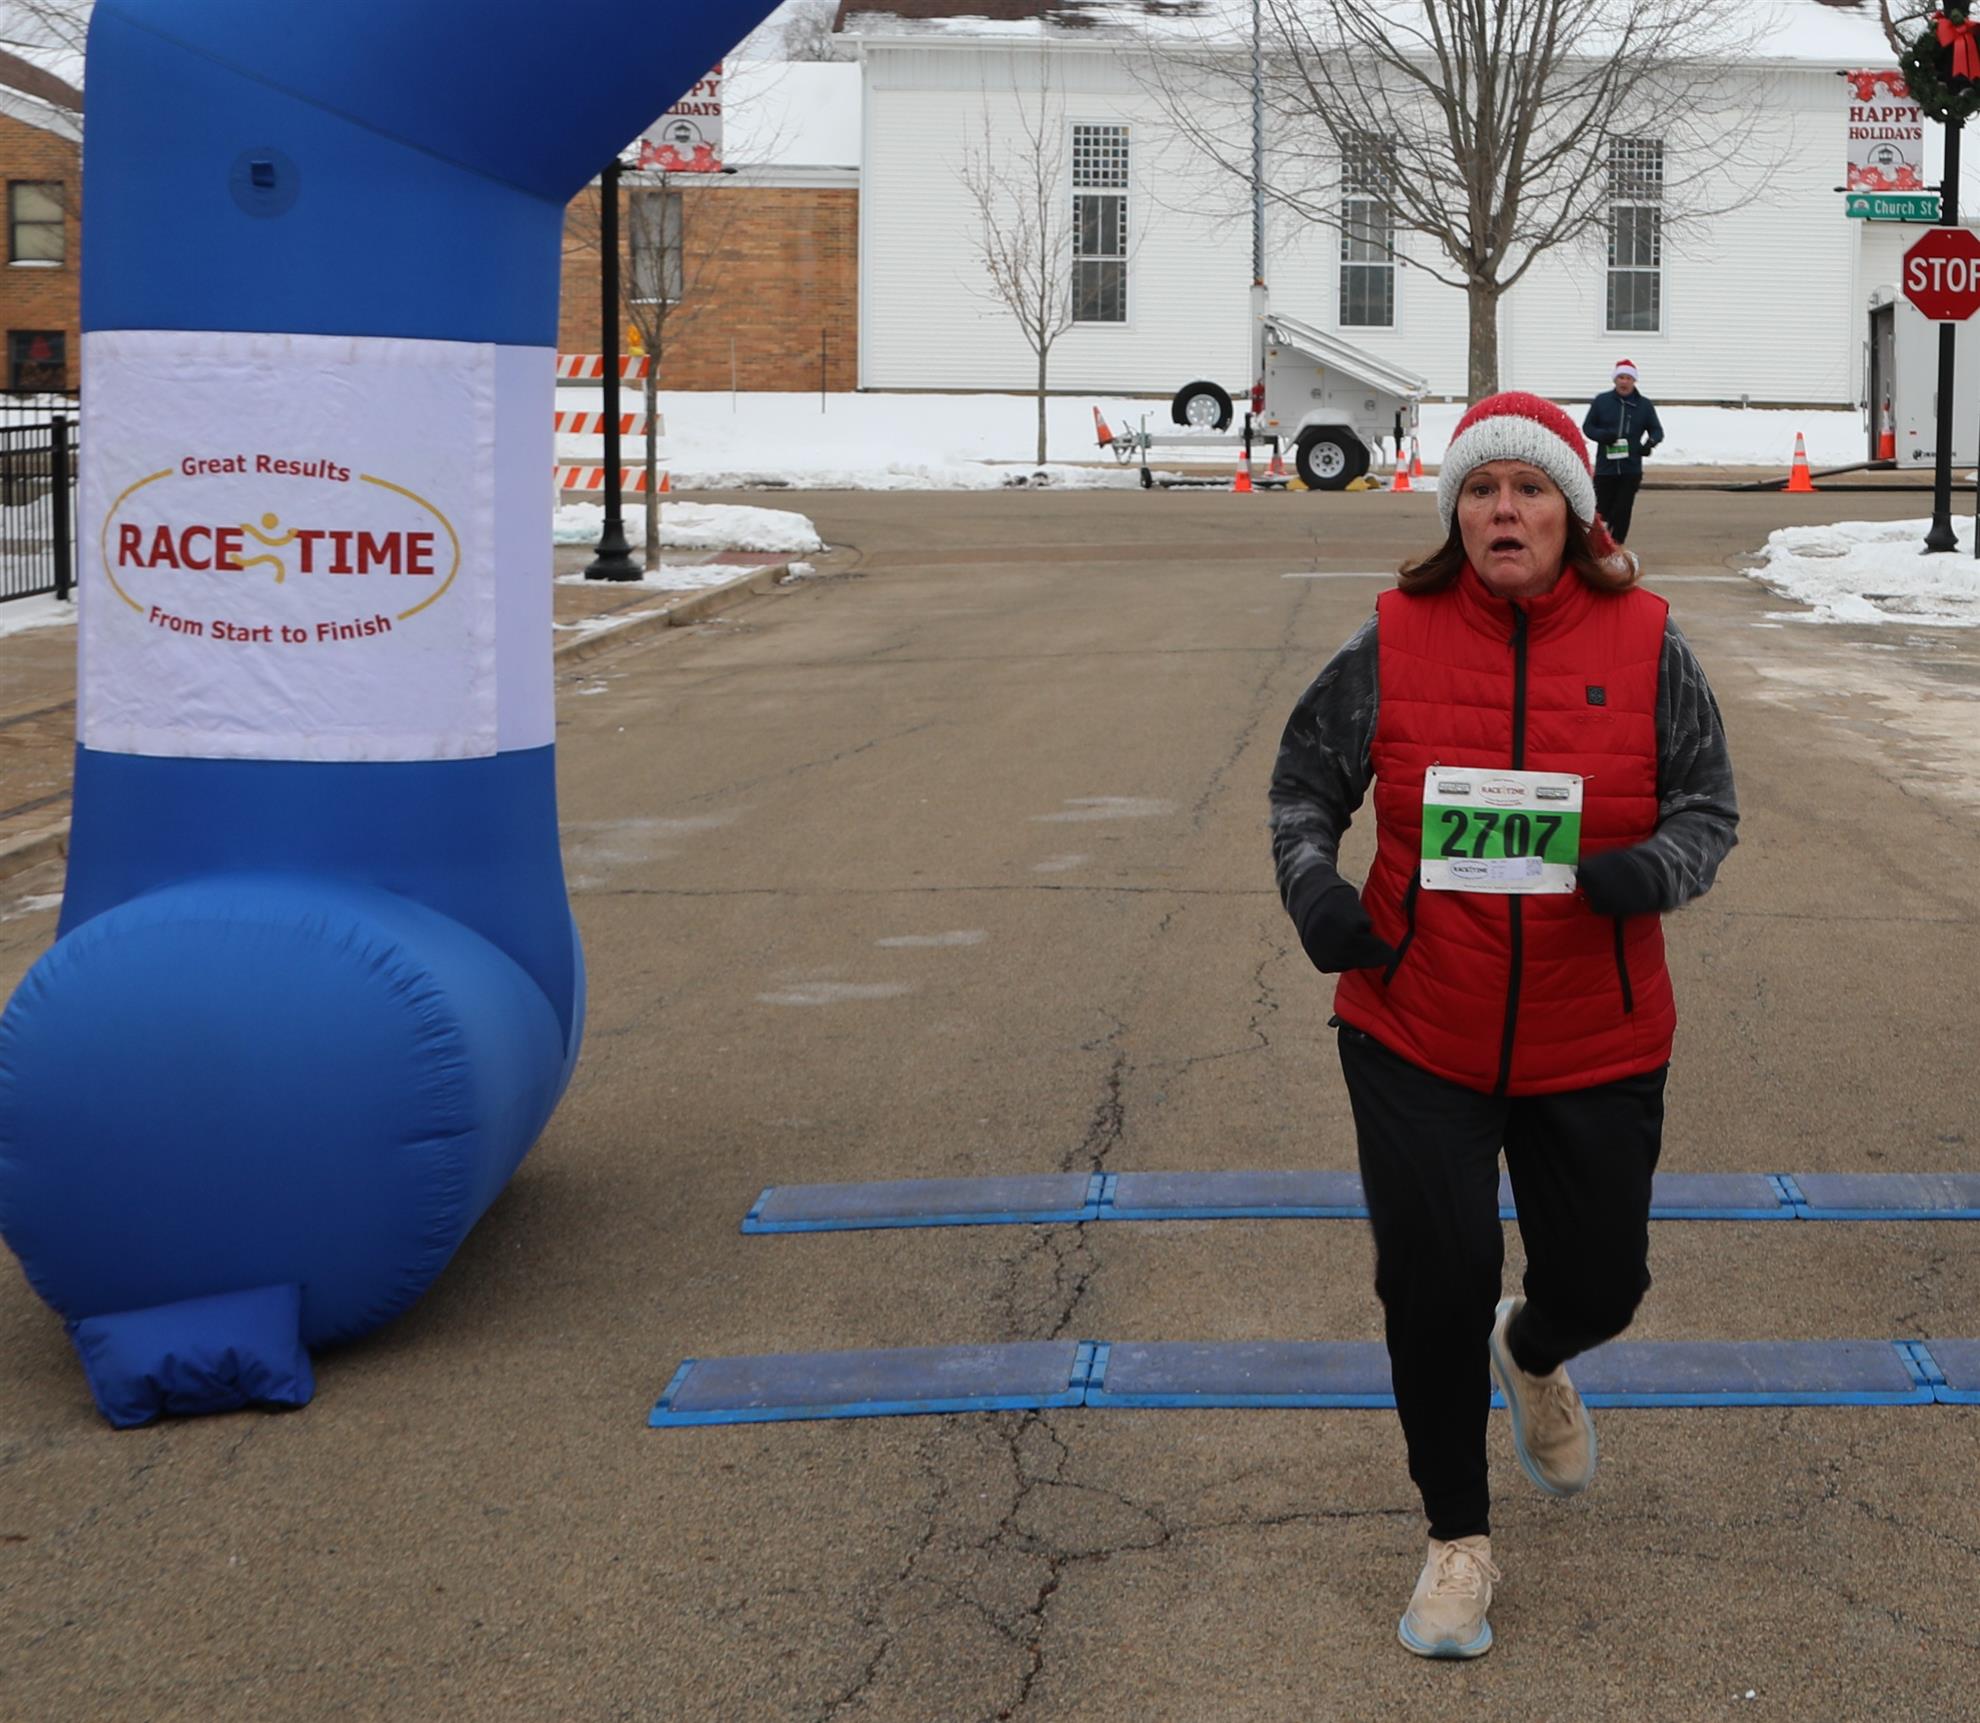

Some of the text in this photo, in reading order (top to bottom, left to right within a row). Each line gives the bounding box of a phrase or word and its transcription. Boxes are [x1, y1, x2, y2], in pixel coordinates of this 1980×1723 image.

[665, 102, 721, 116] IDAYS
[1849, 106, 1921, 122] HAPPY
[1849, 126, 1922, 140] HOLIDAYS
[1875, 200, 1932, 215] Church St
[182, 454, 351, 482] Great Results
[118, 524, 434, 575] RACE TIME
[149, 606, 392, 643] From Start to Finish
[1441, 810, 1562, 862] 2707
